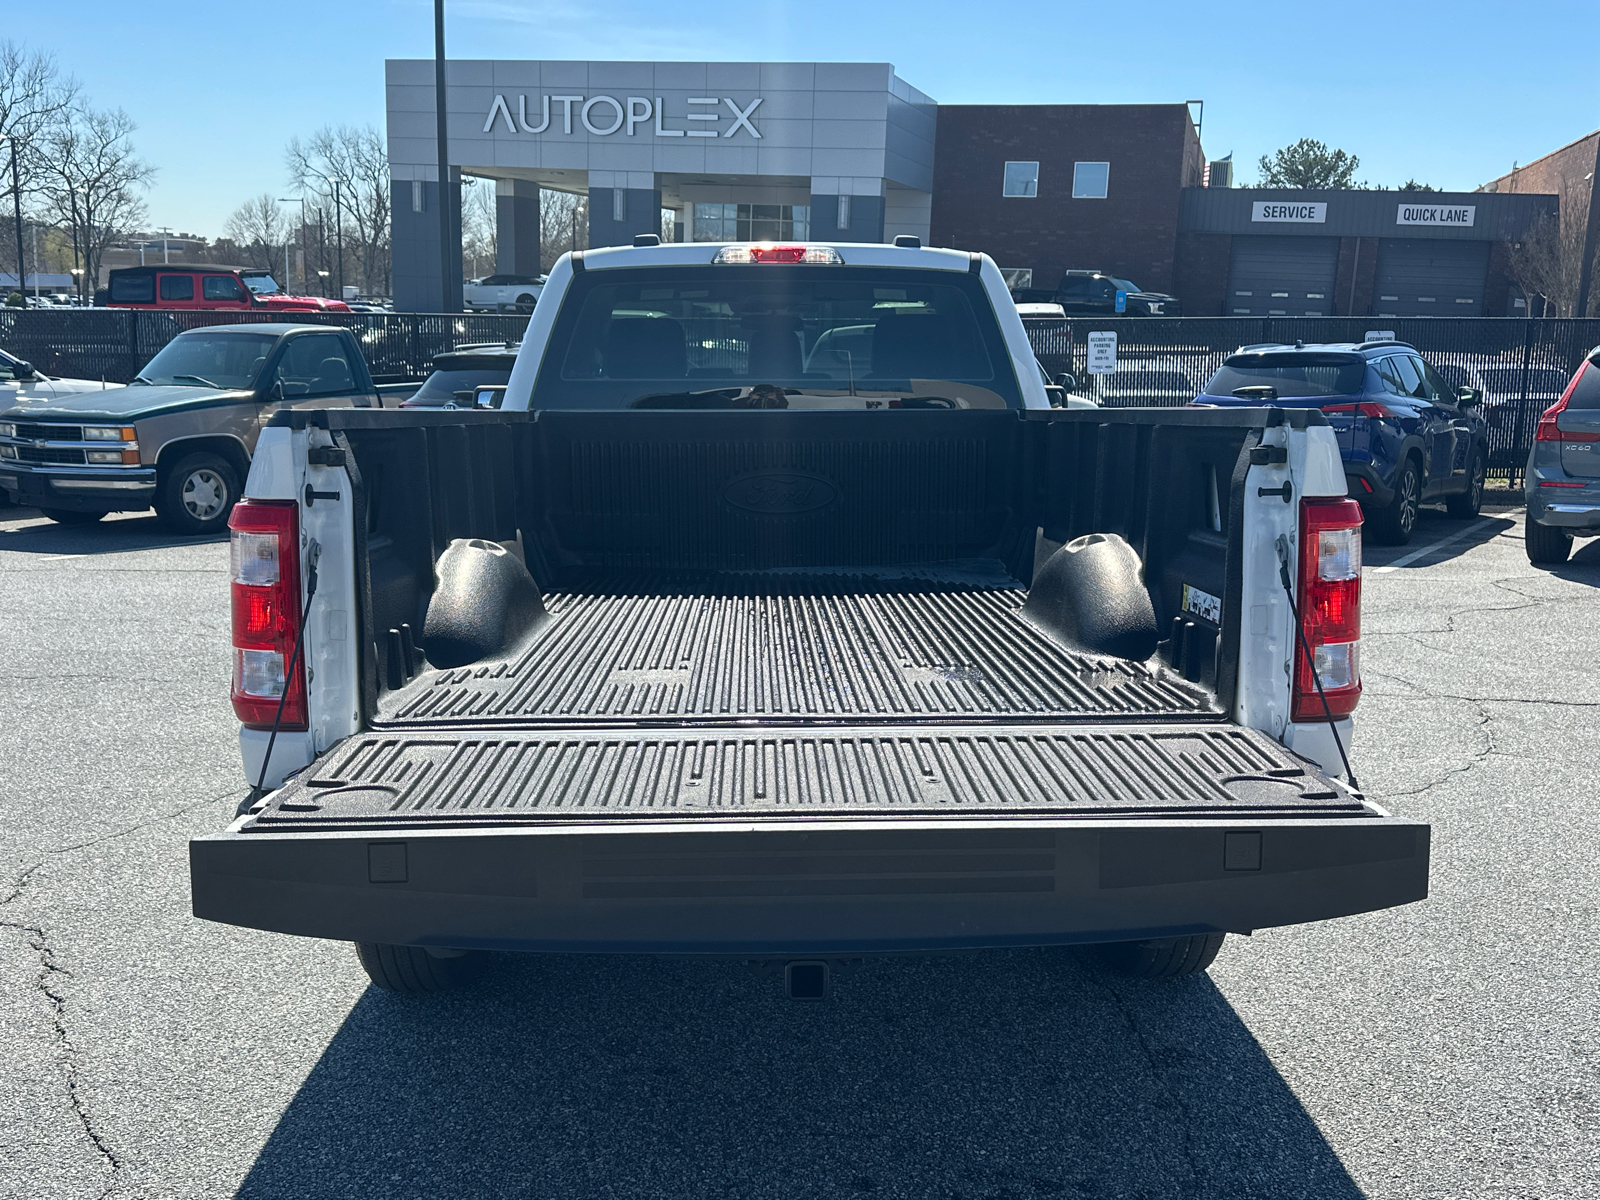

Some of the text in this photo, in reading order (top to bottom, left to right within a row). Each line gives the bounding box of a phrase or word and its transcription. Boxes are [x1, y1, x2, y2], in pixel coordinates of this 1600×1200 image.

[482, 94, 764, 139] AUTOPLEX
[1263, 205, 1316, 219] SERVICE
[1403, 208, 1469, 222] QUICK LANE
[746, 478, 815, 506] Ford
